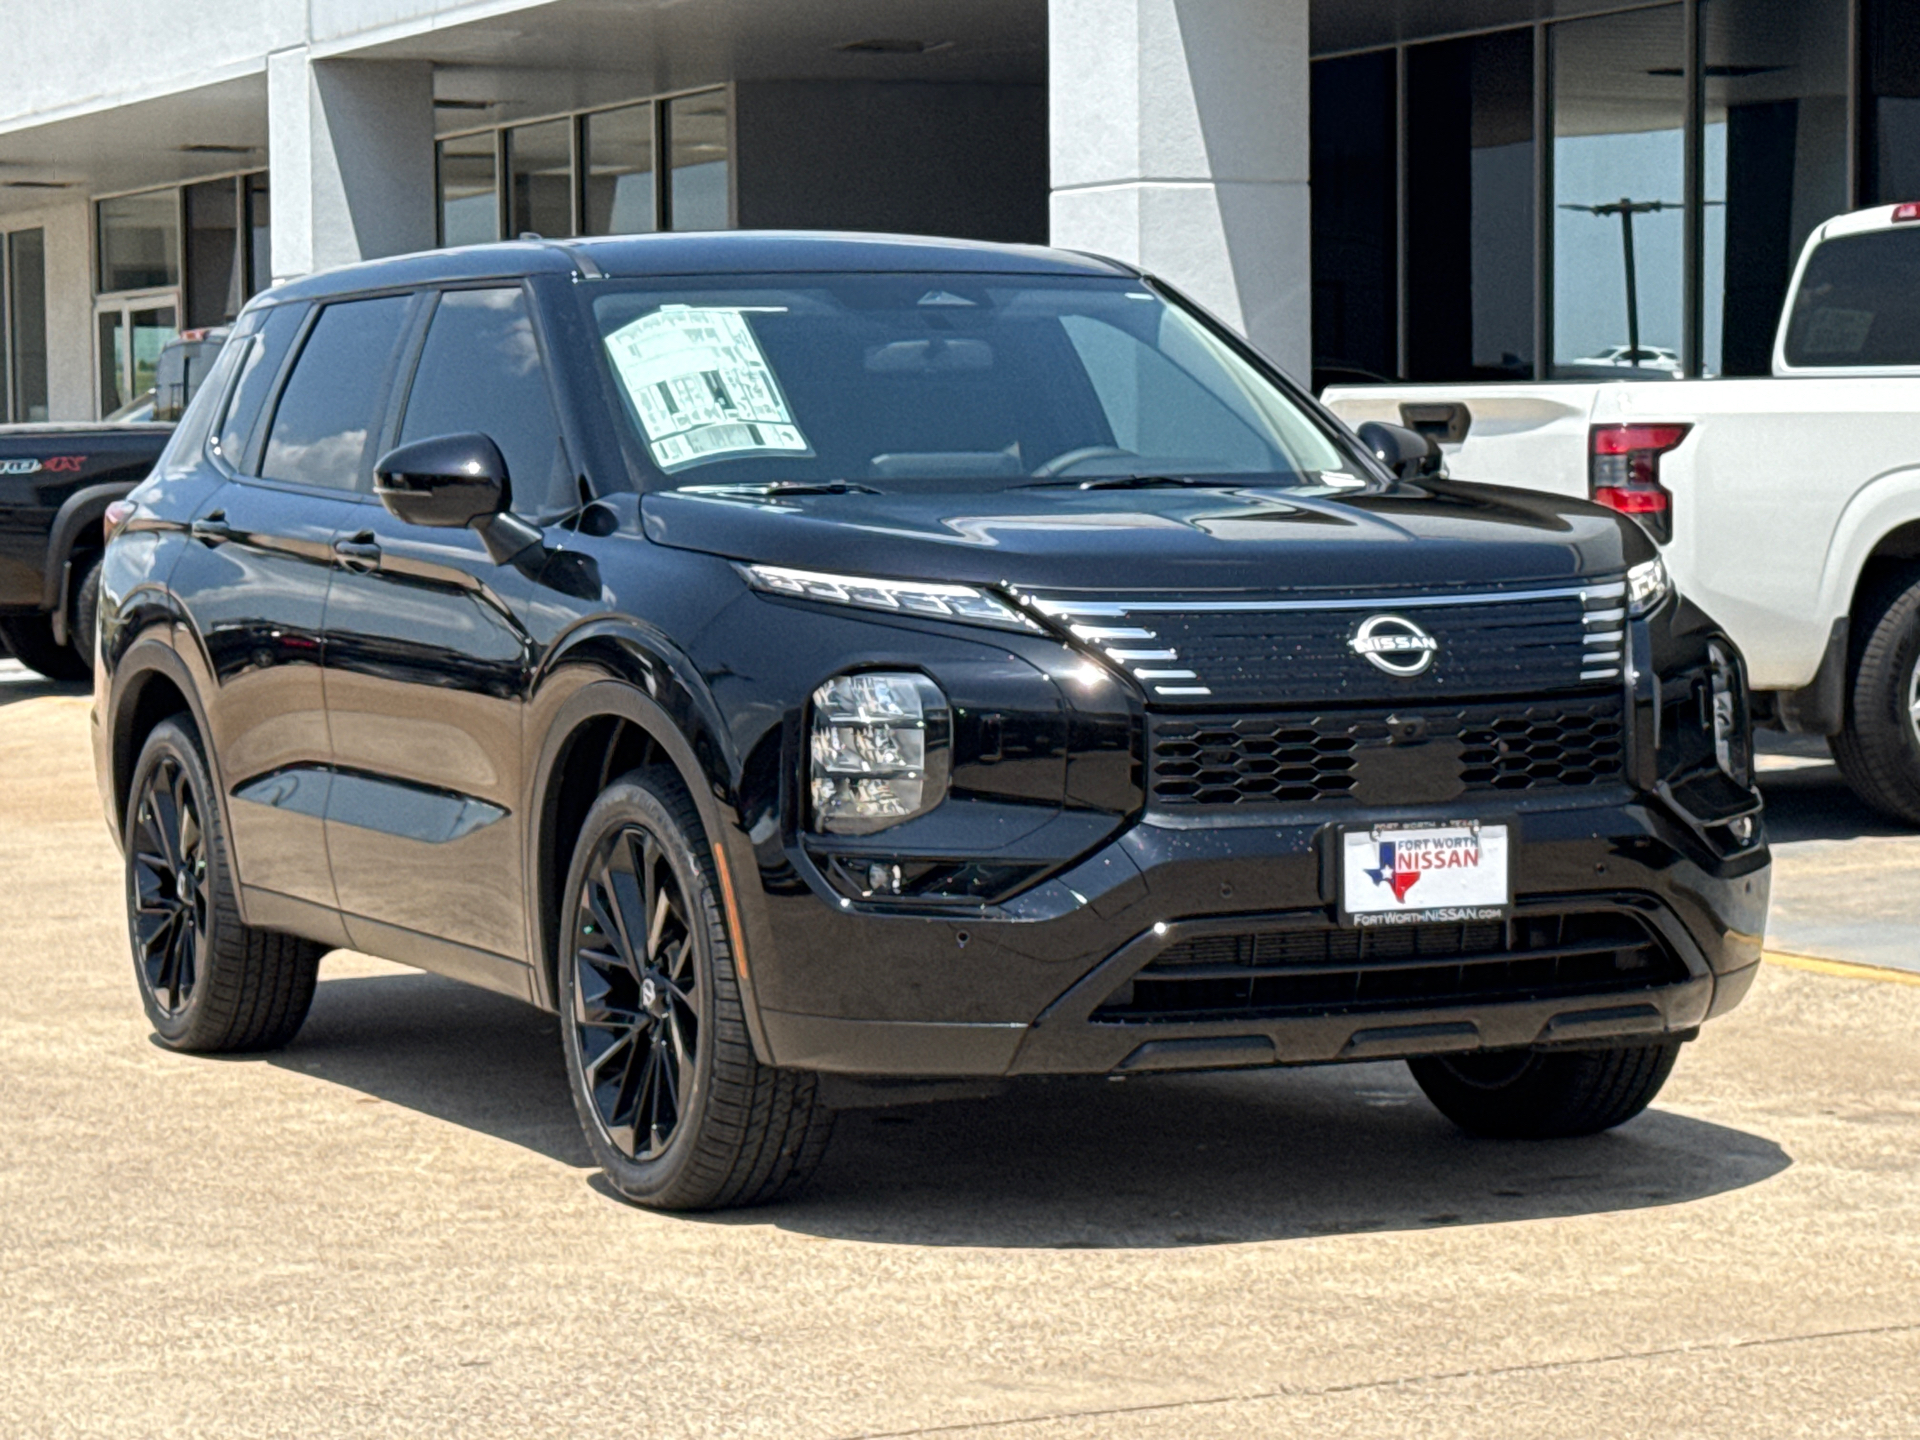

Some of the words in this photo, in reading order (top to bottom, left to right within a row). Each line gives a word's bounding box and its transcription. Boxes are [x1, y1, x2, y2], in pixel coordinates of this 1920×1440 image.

[1354, 636, 1438, 653] NISSAN
[1398, 839, 1430, 851] FORT
[1432, 837, 1478, 849] WORTH
[1398, 849, 1478, 870] NISSAN
